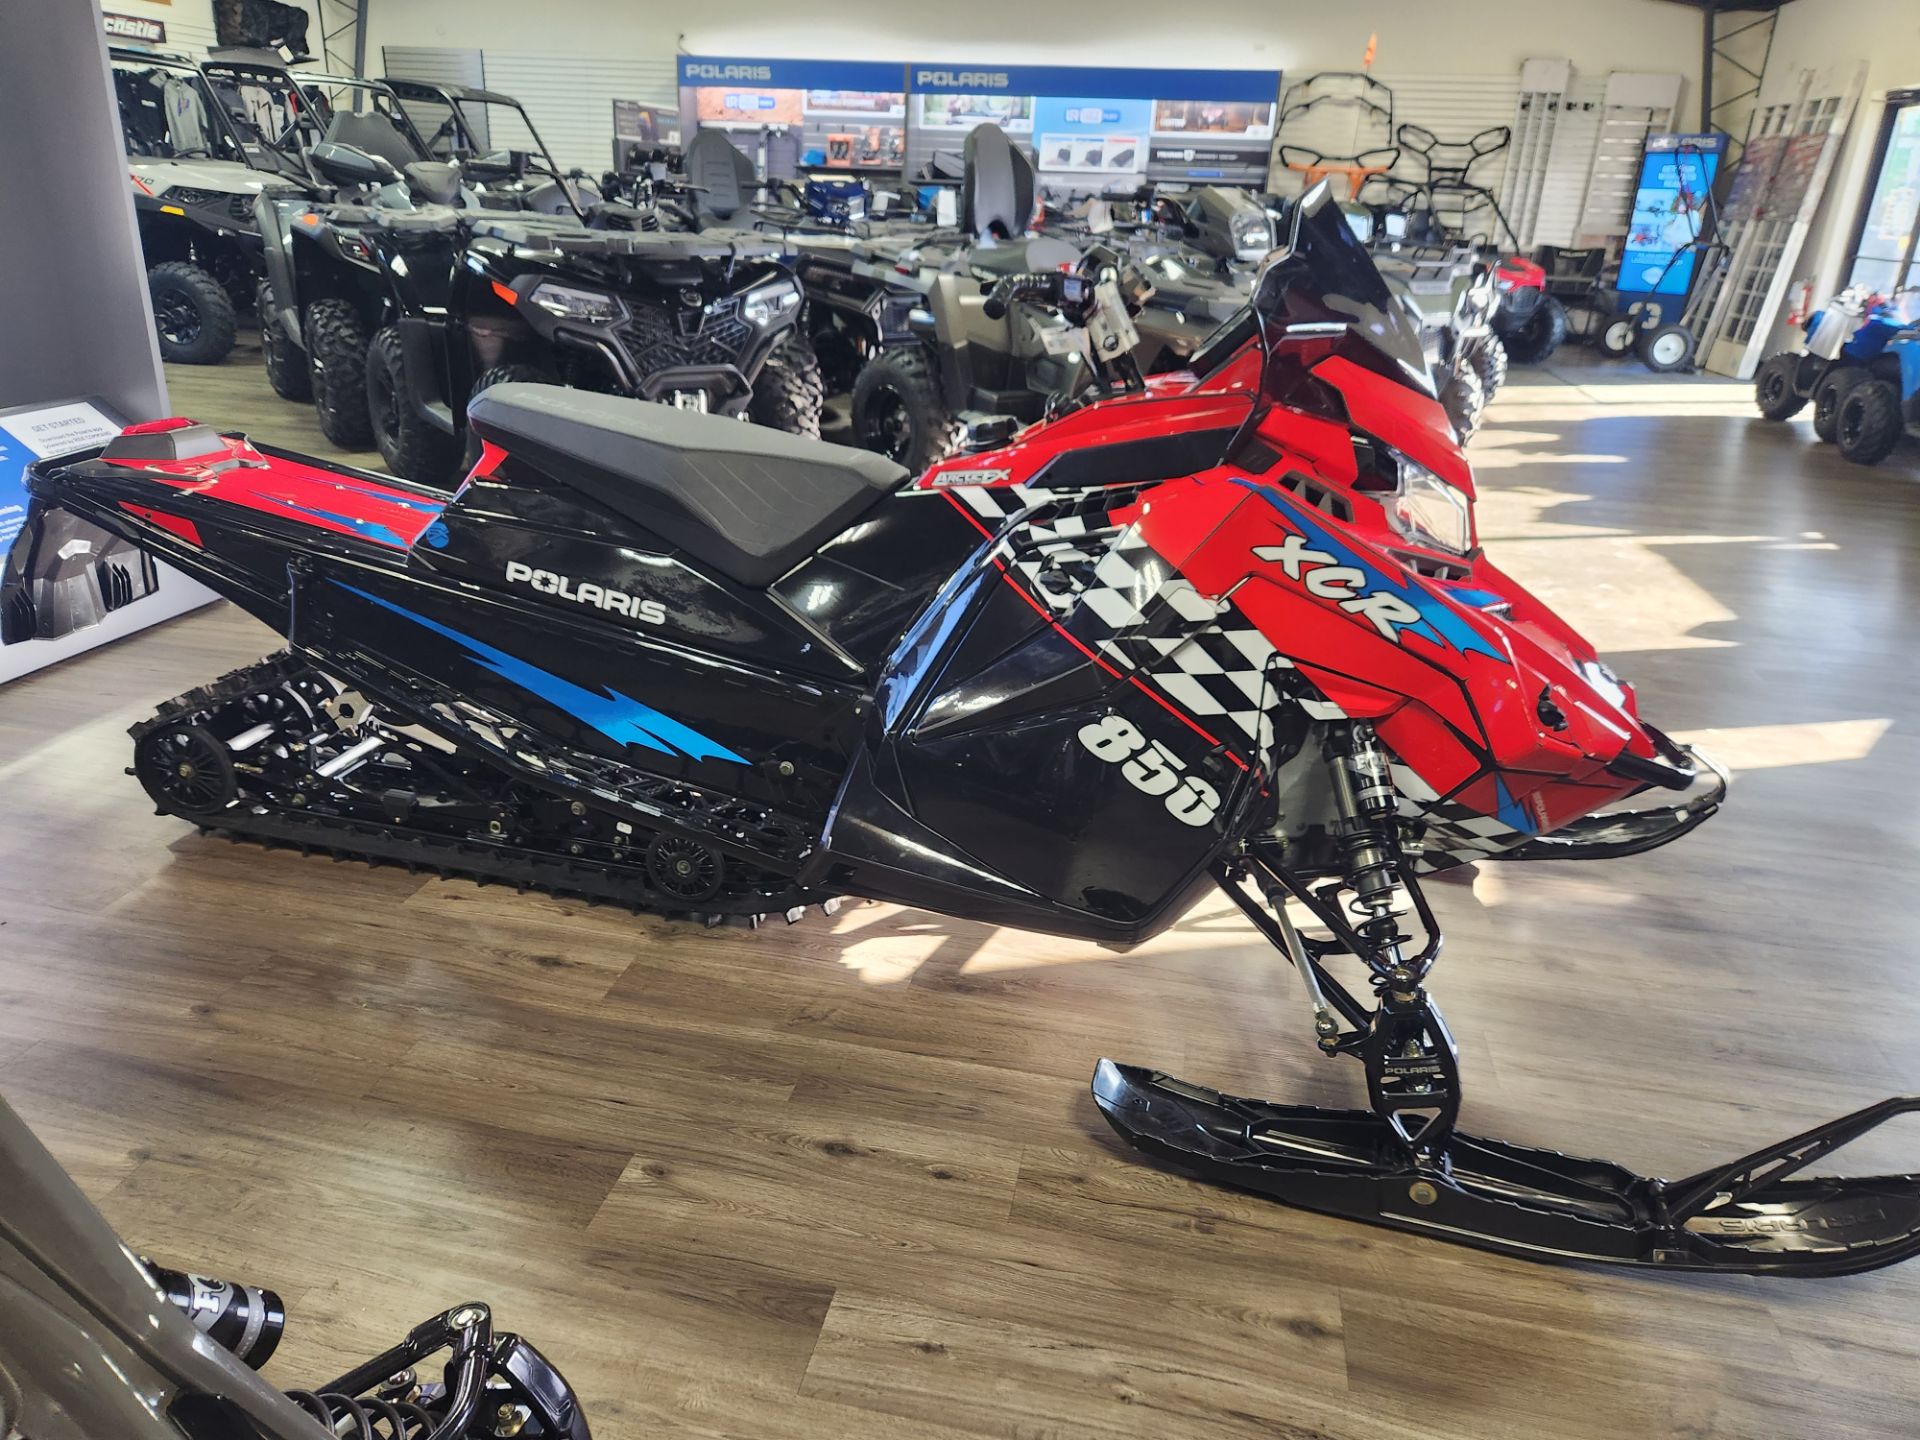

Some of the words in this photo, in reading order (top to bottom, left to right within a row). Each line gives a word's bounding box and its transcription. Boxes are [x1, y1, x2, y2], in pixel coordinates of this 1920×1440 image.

[685, 63, 771, 80] POLARIS
[917, 71, 1009, 87] POLARIS
[505, 561, 667, 625] POLARIS
[1251, 535, 1421, 644] XCR
[1077, 715, 1221, 827] 850
[1384, 1065, 1441, 1075] POLARIS
